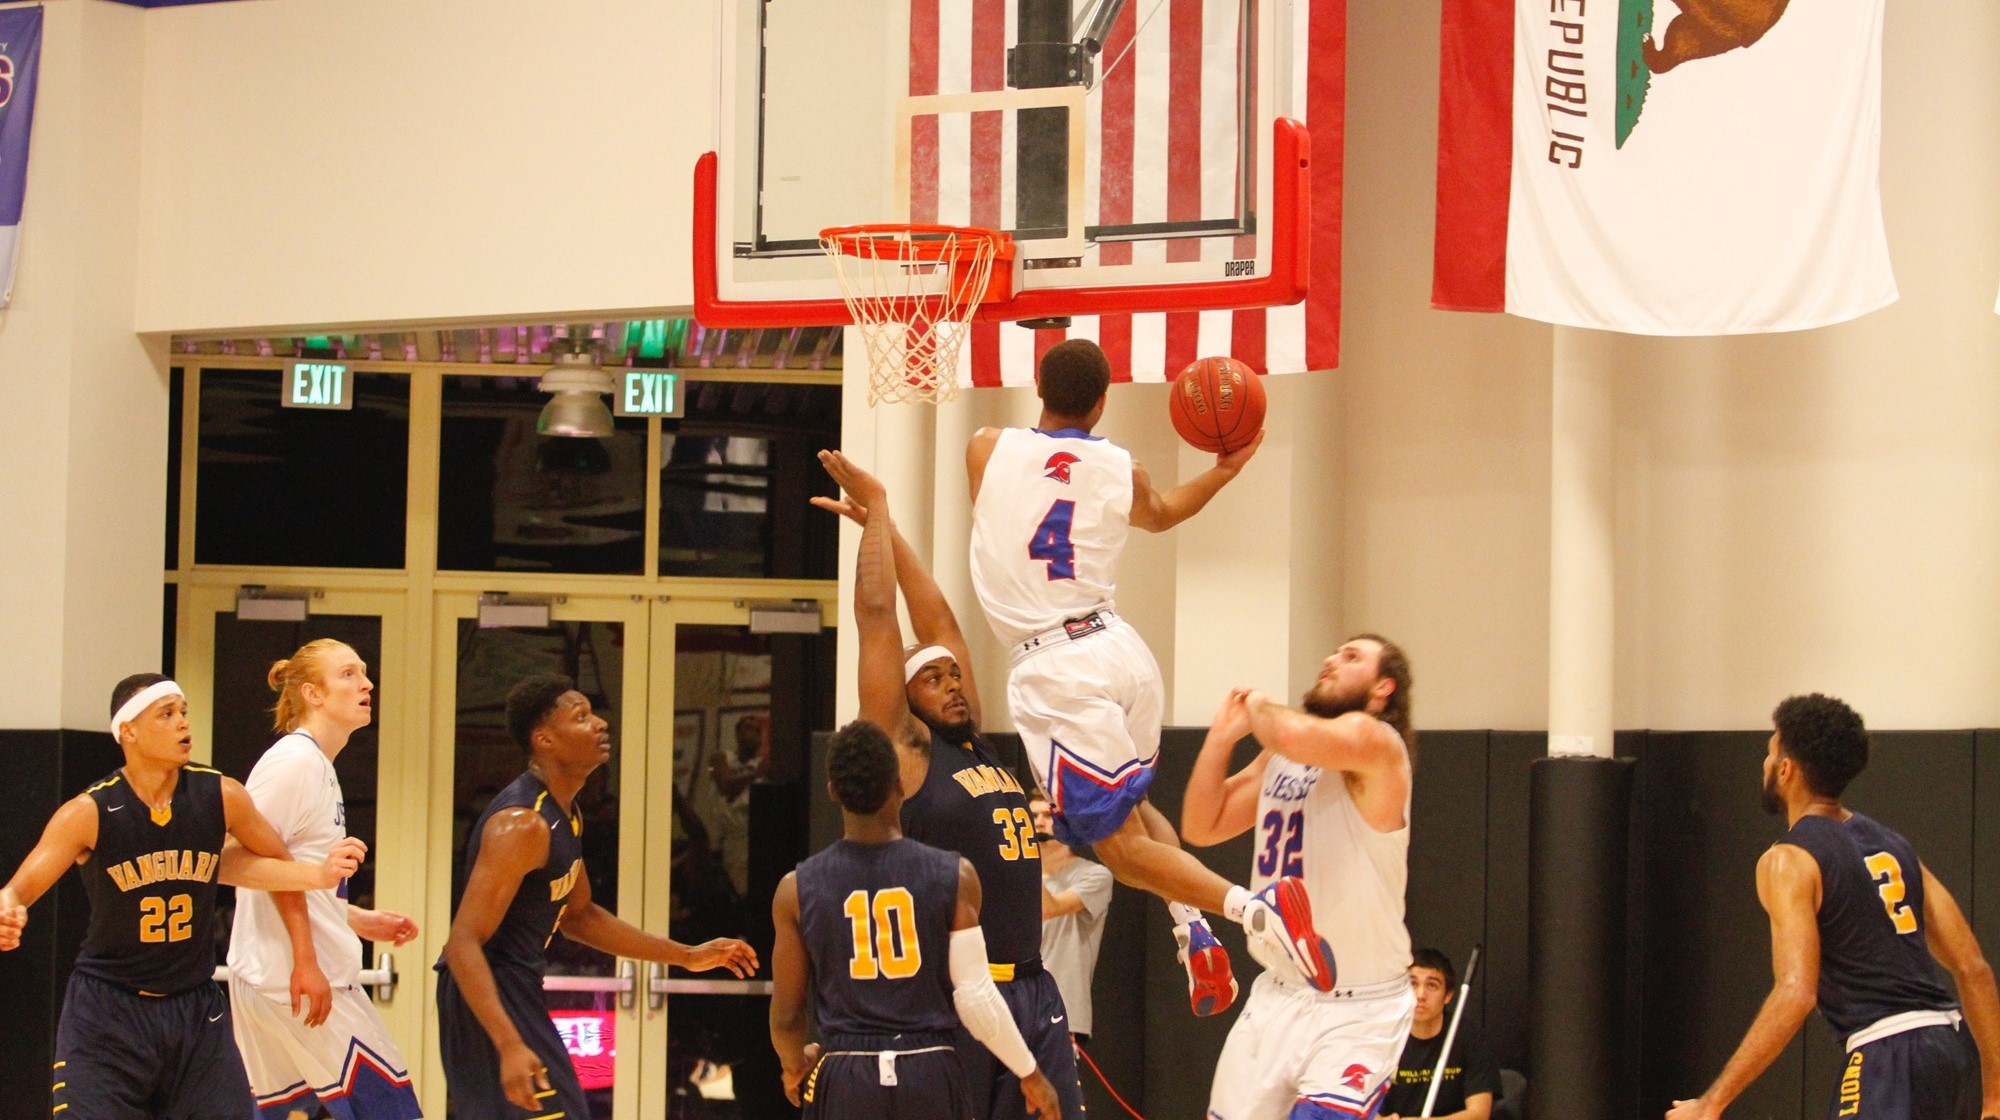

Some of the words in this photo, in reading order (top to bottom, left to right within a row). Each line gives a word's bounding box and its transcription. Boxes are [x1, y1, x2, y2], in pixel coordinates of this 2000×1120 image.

[293, 363, 346, 405] EXIT
[625, 372, 677, 413] EXIT
[1028, 498, 1076, 581] 4
[992, 806, 1039, 861] 32
[1257, 808, 1304, 879] 32
[140, 893, 193, 943] 22
[1863, 851, 1918, 934] 2
[843, 886, 922, 980] 10
[1839, 1052, 1863, 1117] LIONS
